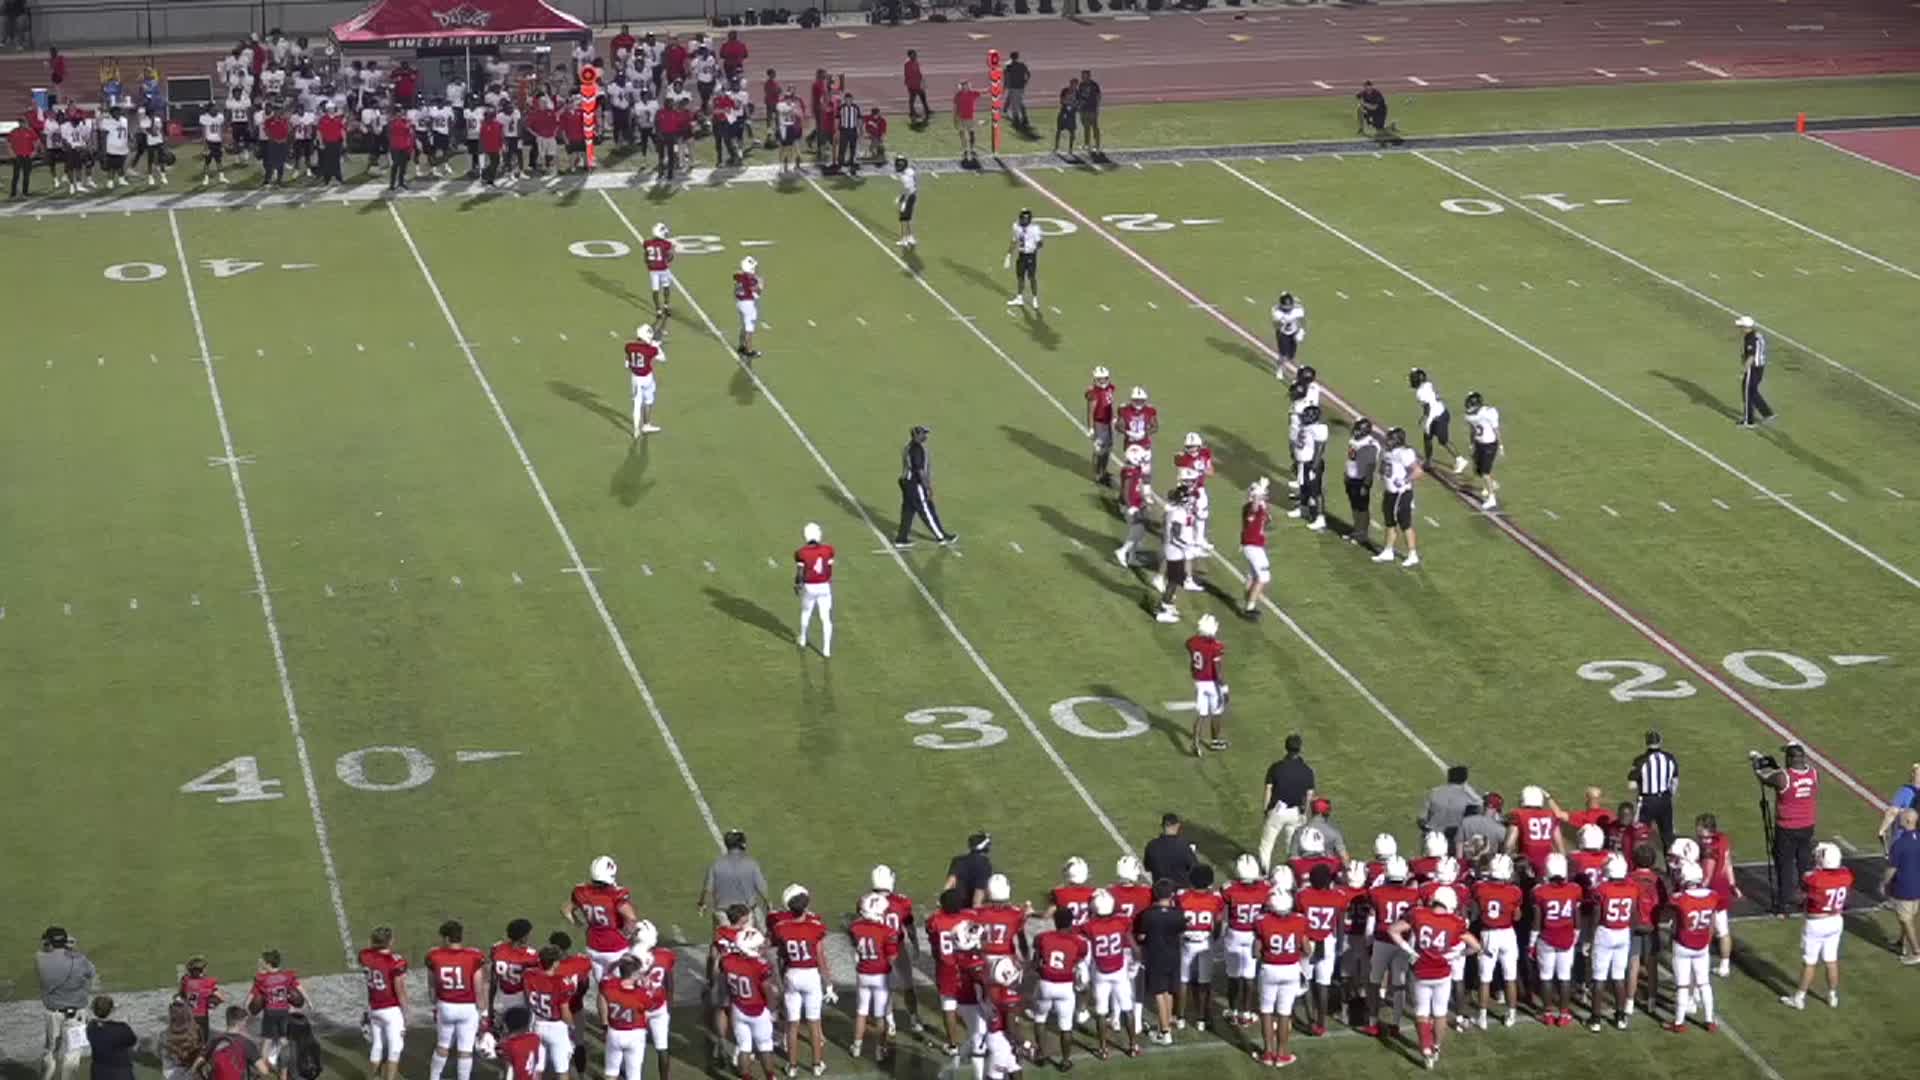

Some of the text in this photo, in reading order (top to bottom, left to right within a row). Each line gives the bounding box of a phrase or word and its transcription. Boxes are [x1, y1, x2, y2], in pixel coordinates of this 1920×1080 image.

[646, 246, 663, 262] 21
[630, 351, 645, 368] 12
[812, 556, 823, 575] 4
[1193, 651, 1204, 670] 9
[1528, 816, 1553, 840] 97
[1546, 899, 1573, 920] 24
[1605, 897, 1633, 922] 53
[1822, 886, 1848, 912] 78
[1307, 906, 1335, 930] 57
[983, 922, 1007, 945] 17
[1095, 931, 1121, 958] 22
[1269, 933, 1297, 955] 94
[1419, 924, 1448, 950] 64
[786, 939, 813, 962] 91
[856, 936, 879, 960] 41
[439, 965, 466, 990] 51
[727, 972, 753, 999] 50
[608, 1002, 634, 1023] 74
